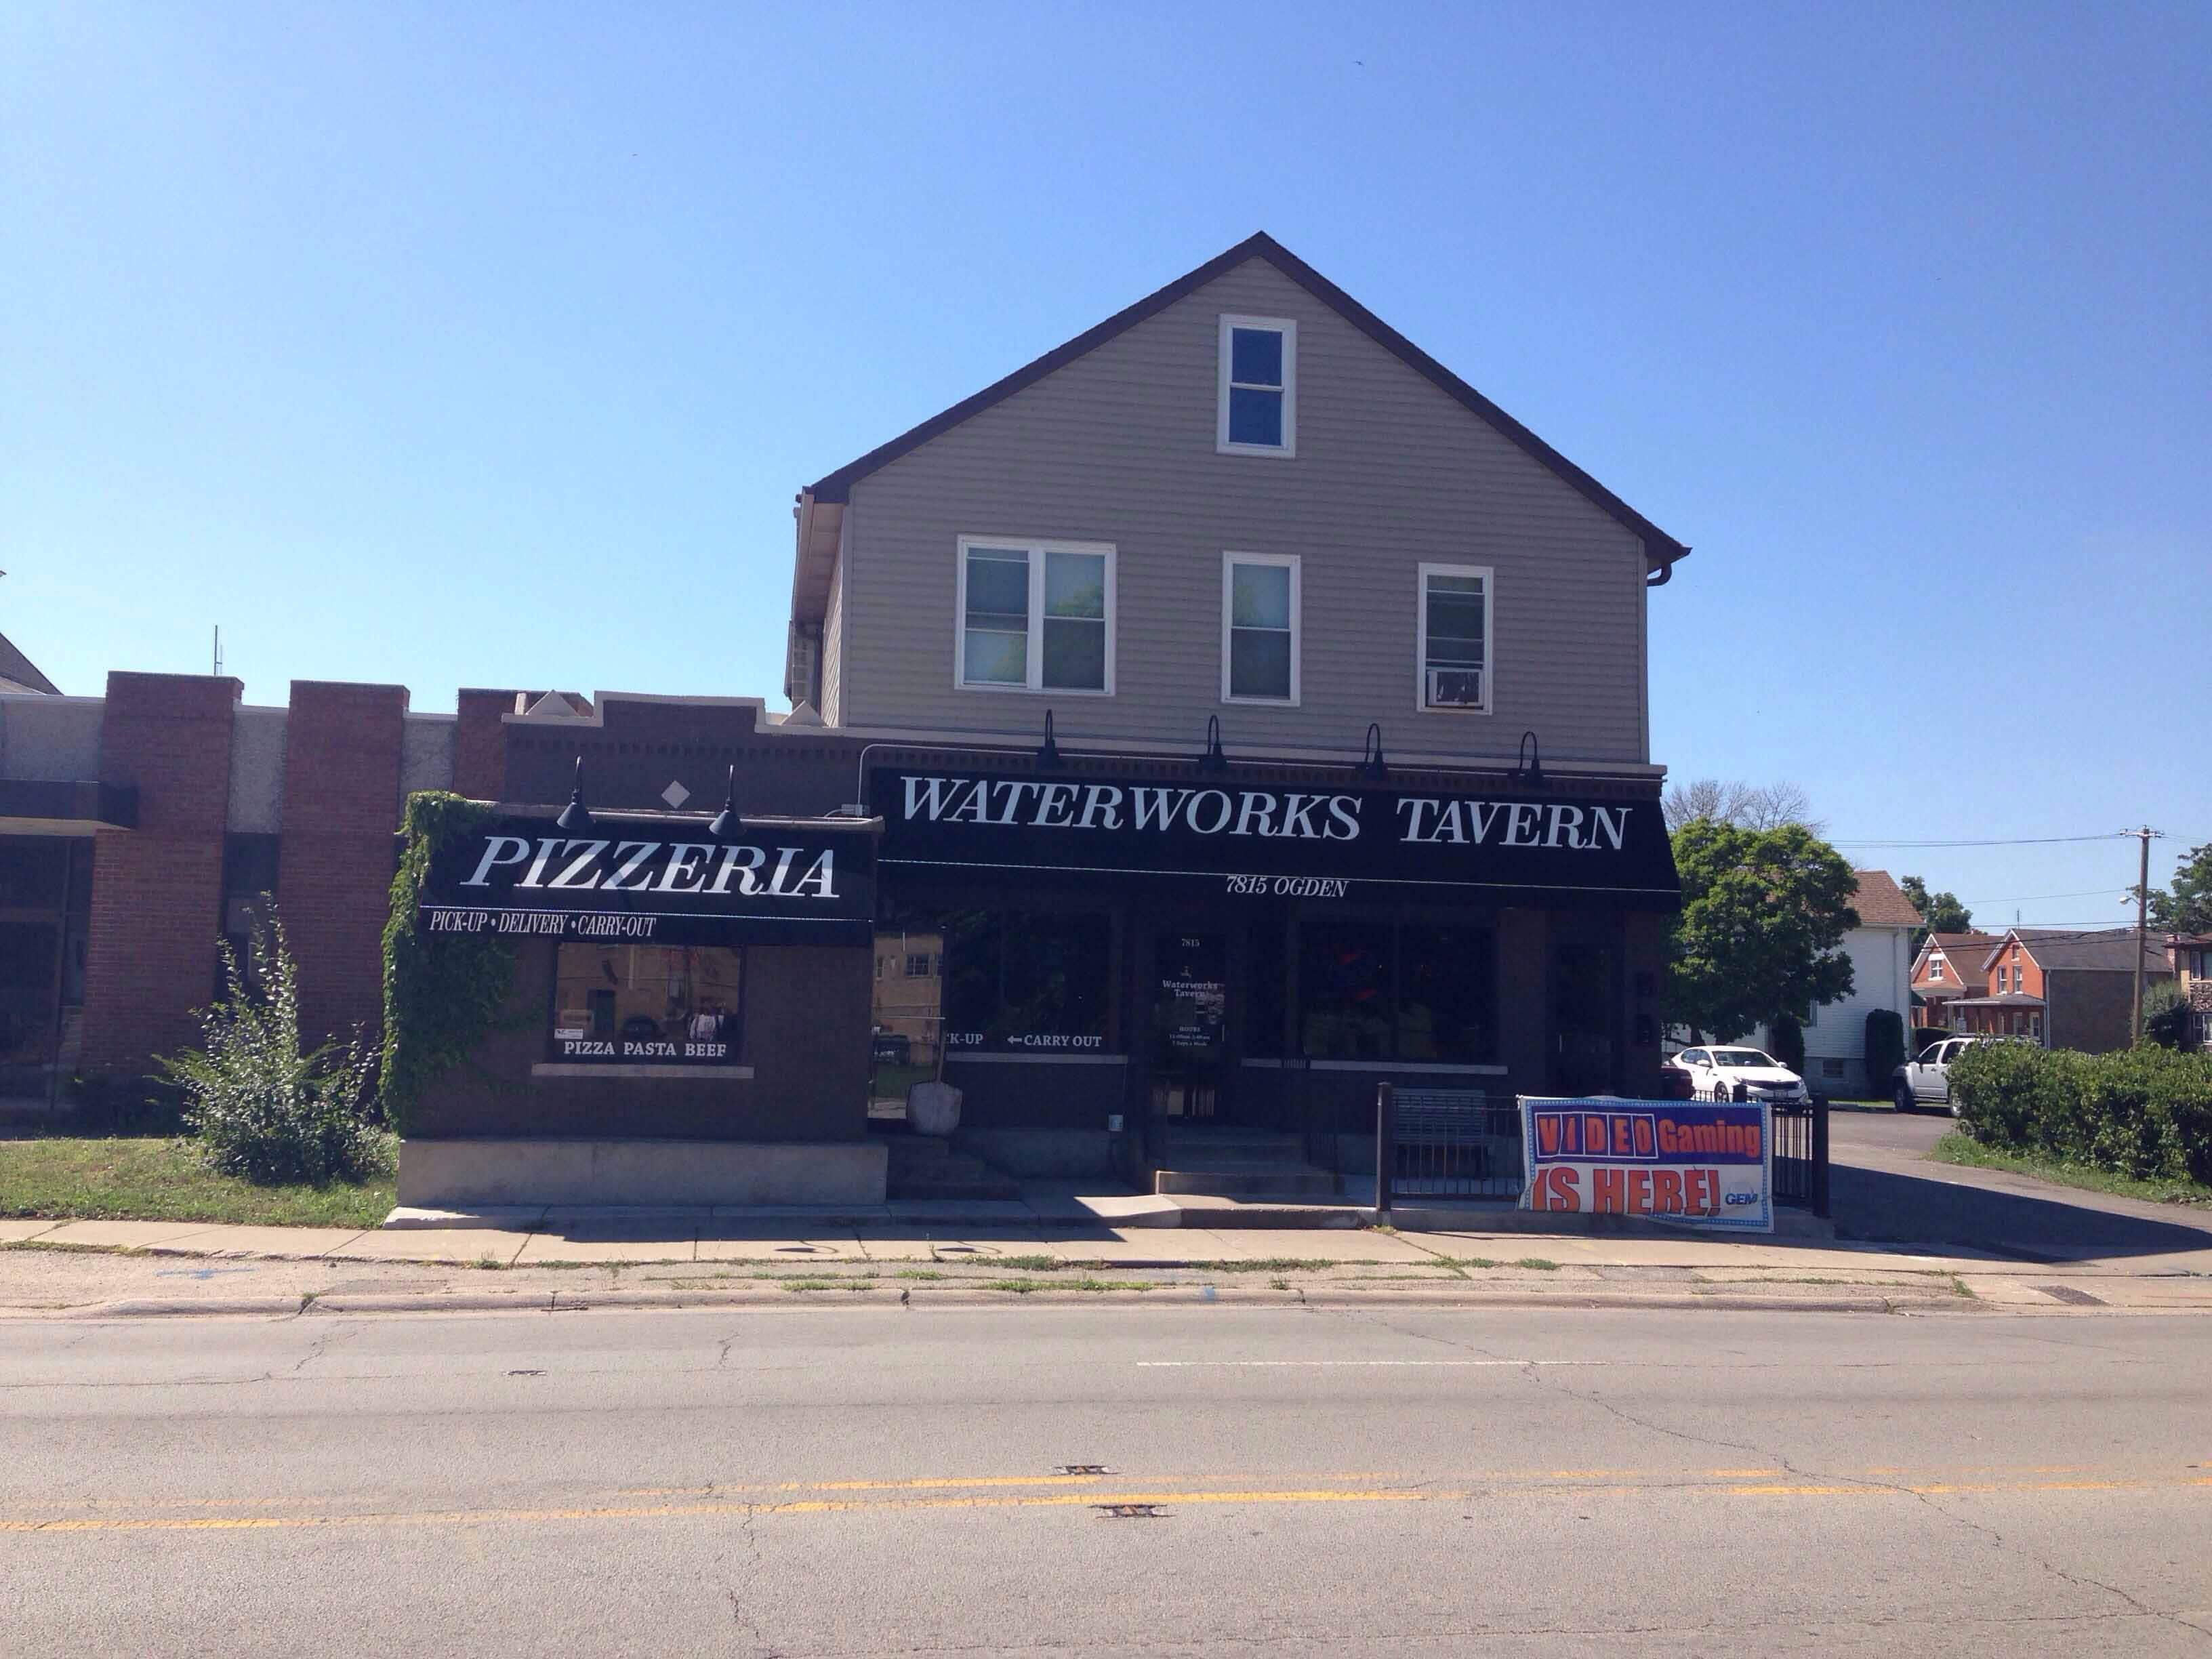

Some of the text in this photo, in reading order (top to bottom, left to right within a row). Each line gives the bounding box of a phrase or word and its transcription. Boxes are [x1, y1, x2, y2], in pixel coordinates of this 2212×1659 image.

[900, 776, 1633, 850] WATERWORKS TAVERN
[459, 836, 840, 898] PIZZERIA
[1226, 876, 1349, 898] 7815 OGDEN
[429, 911, 657, 937] PICK-UP DELIVERY CARRY-OUT
[1181, 938, 1200, 947] 7815
[1162, 979, 1218, 989] Waterworks
[1174, 988, 1206, 998] Tavern
[947, 1033, 984, 1044] K-UP
[1024, 1034, 1102, 1047] CARRY OUT
[564, 1041, 727, 1057] PIZZA PASTA BEEF
[1538, 1117, 1760, 1158] VIDEO Gaming
[1533, 1167, 1721, 1216] IS HERE!
[1725, 1193, 1758, 1205] GEM
